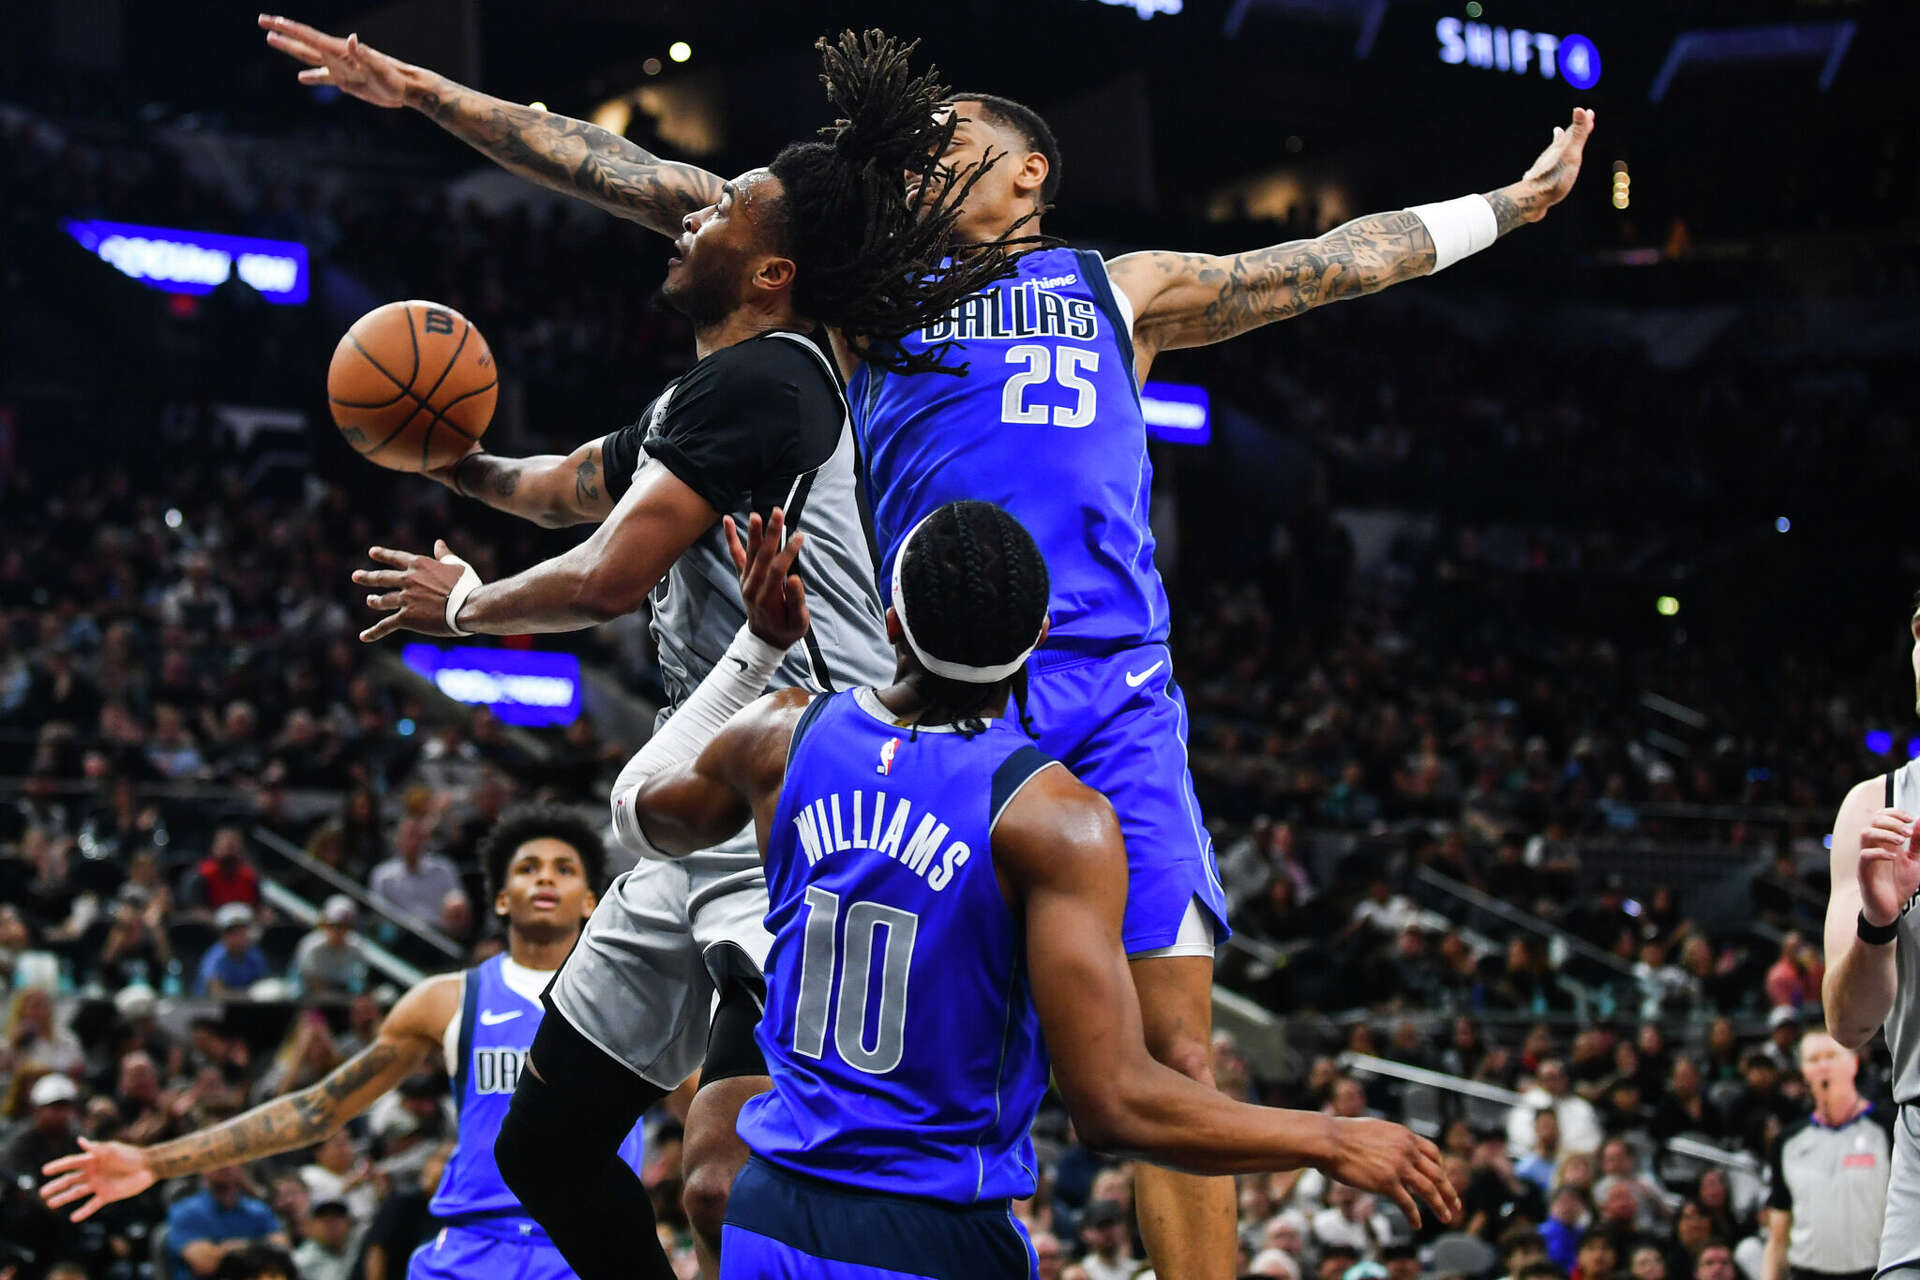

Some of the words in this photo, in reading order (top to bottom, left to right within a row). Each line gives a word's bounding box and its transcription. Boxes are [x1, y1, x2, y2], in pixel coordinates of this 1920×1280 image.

[1001, 344, 1100, 428] 25
[793, 790, 971, 892] WILLIAMS
[793, 885, 918, 1074] 10
[474, 1047, 530, 1095] DA
